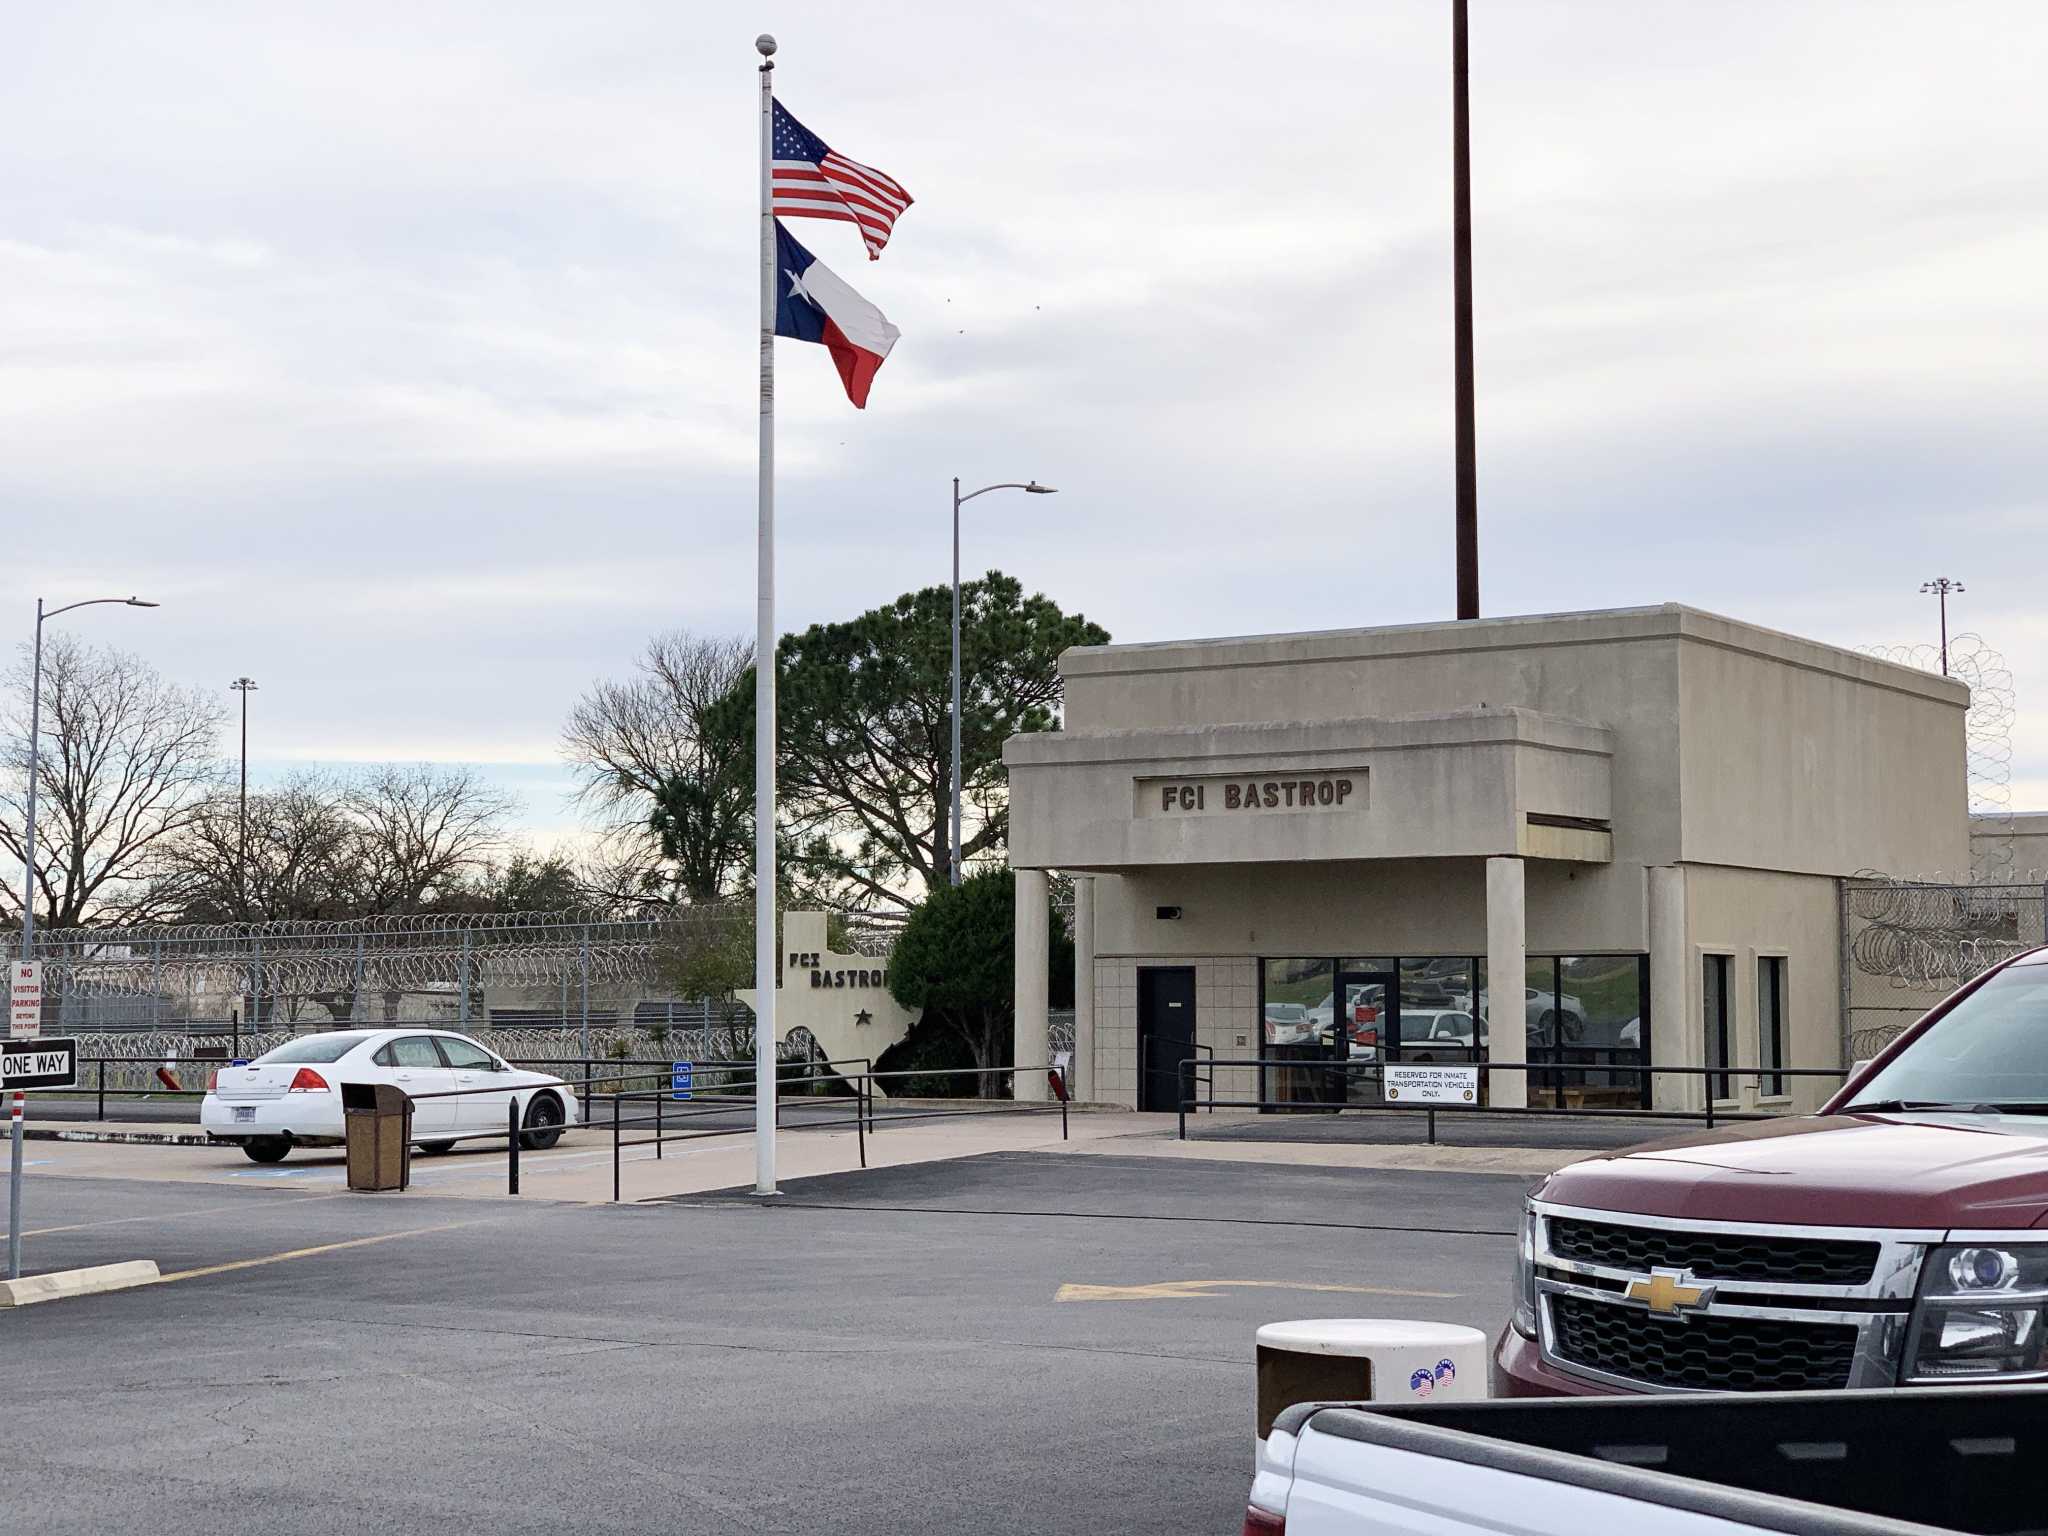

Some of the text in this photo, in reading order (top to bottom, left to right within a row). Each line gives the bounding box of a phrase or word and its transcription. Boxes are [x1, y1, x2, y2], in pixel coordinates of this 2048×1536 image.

[1162, 779, 1353, 811] FCI BASTROP
[789, 953, 820, 968] FCI
[21, 969, 32, 977] NO
[3, 1054, 64, 1075] ONE WAY
[1429, 1071, 1442, 1079] FOR
[1387, 1080, 1475, 1089] TRANSPORTATION VEHICLES
